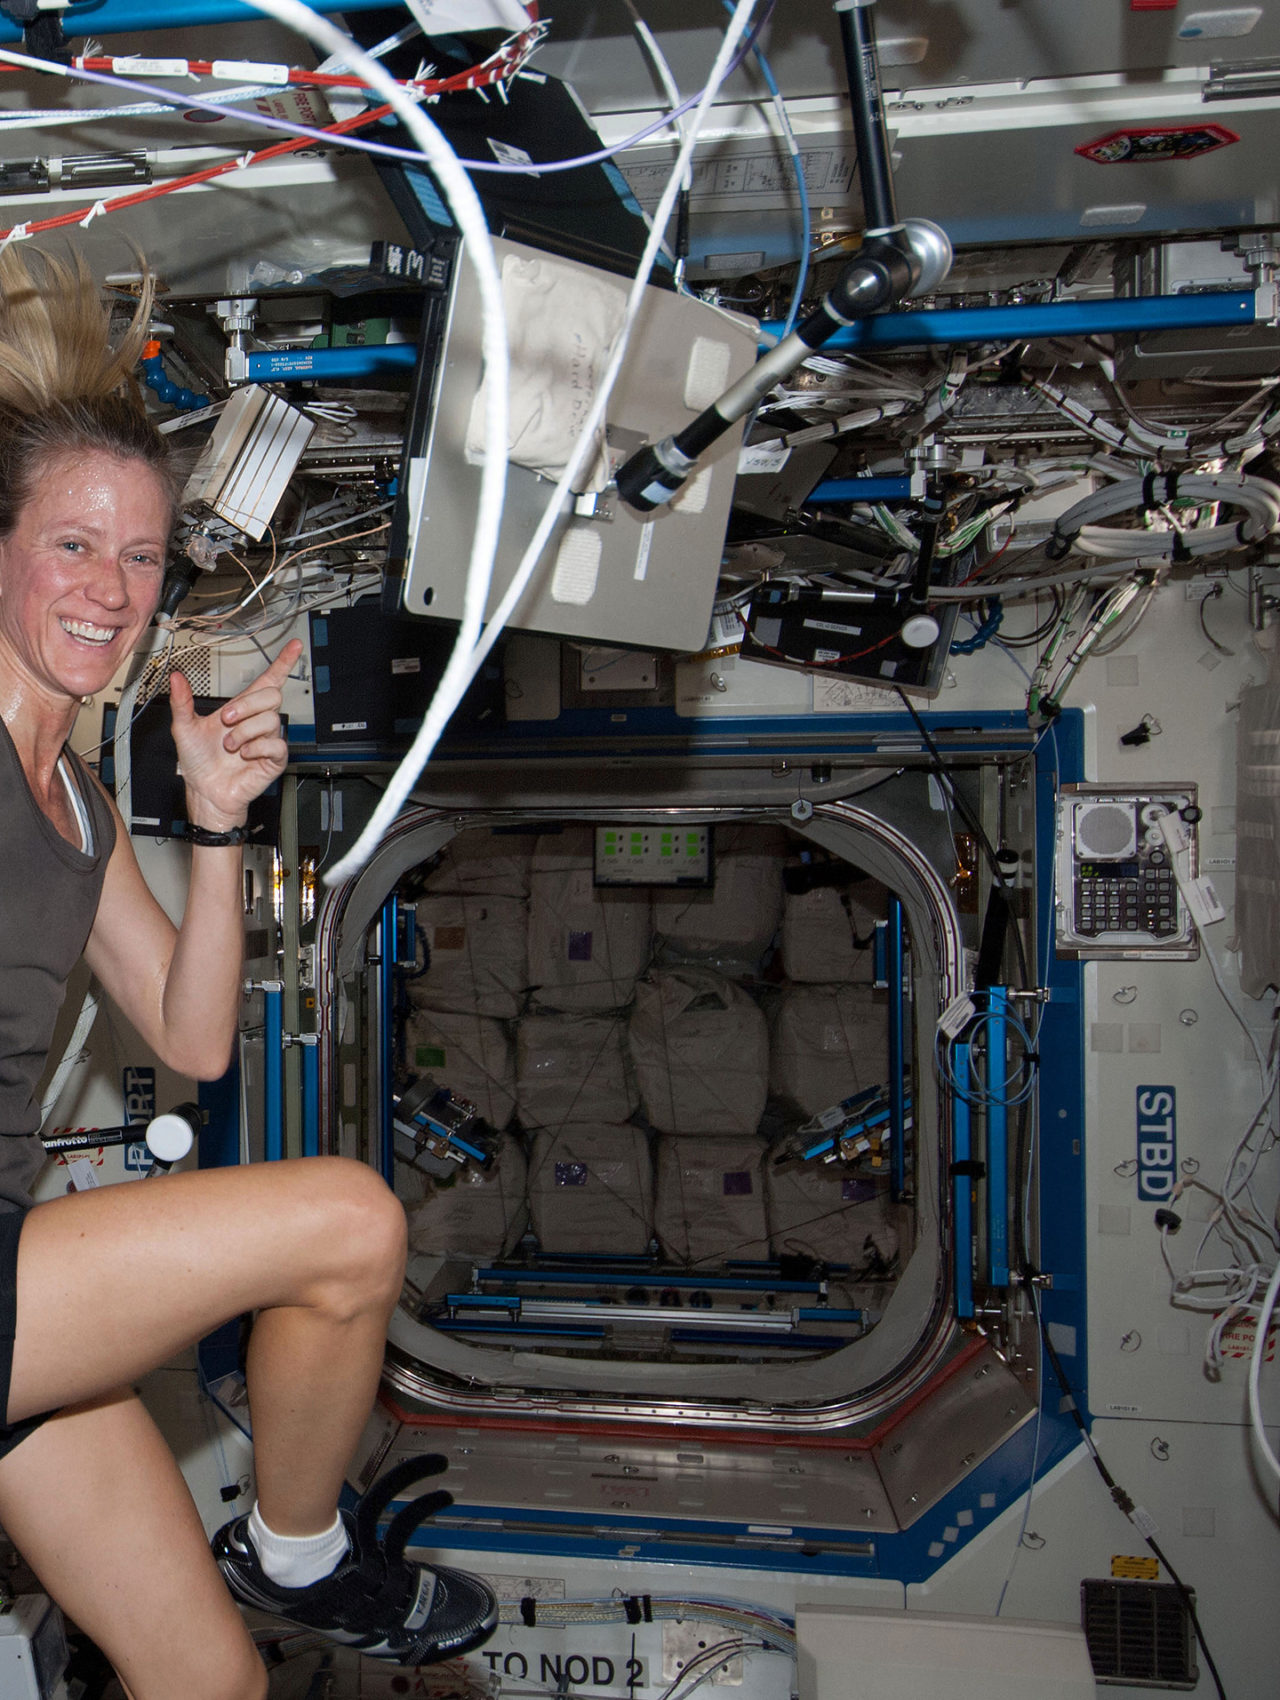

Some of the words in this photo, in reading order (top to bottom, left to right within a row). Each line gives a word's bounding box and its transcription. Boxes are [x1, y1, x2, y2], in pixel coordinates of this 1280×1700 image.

[42, 1136, 88, 1149] anfrotto
[126, 1070, 154, 1166] PRT
[1139, 1091, 1174, 1196] STBD
[482, 1651, 528, 1680] TO
[540, 1653, 615, 1687] NOD
[625, 1658, 645, 1688] 2
